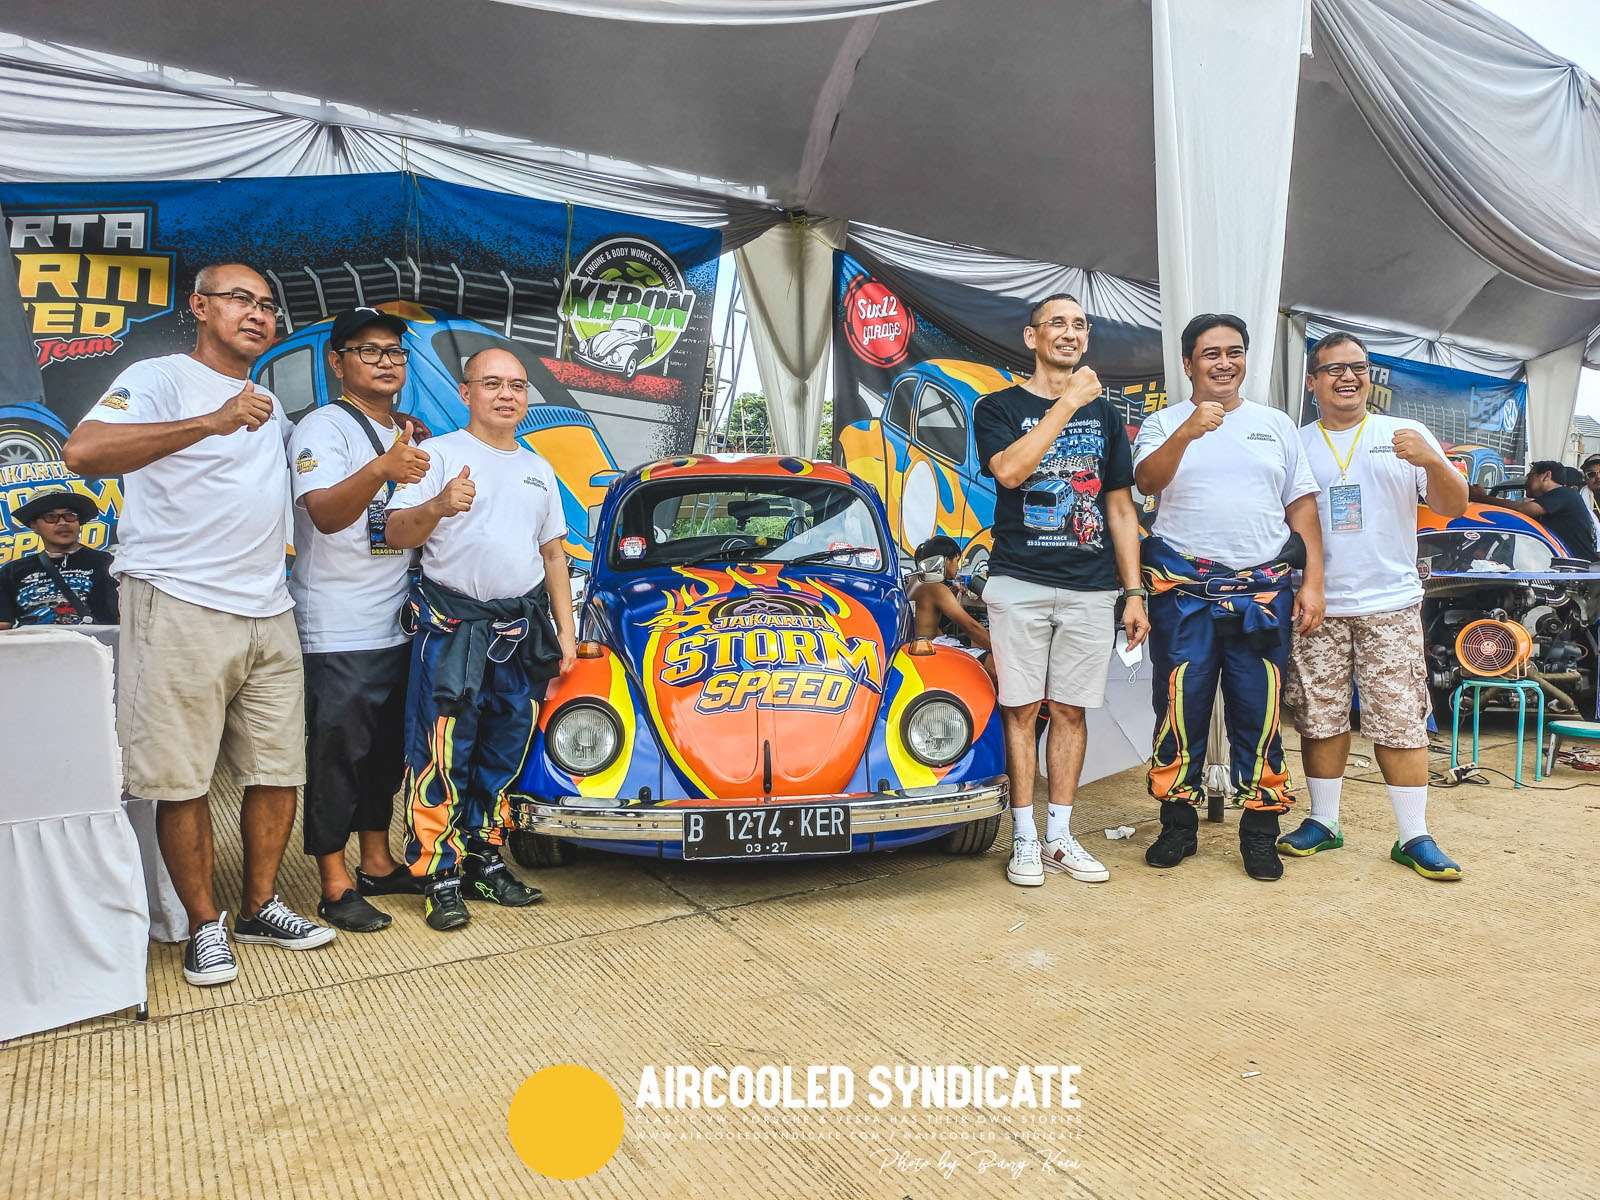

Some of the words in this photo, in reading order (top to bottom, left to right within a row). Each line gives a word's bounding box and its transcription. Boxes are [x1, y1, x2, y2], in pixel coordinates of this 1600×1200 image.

[585, 254, 606, 276] ENGINE
[605, 252, 612, 260] &
[611, 248, 629, 258] BODY
[630, 248, 653, 262] WORKS
[651, 257, 678, 291] SPECIALIST
[23, 302, 125, 336] ED
[858, 296, 898, 320] Six12
[38, 336, 119, 366] Team
[713, 614, 832, 630] JAKARTA
[661, 629, 882, 692] STORM
[697, 671, 855, 712] SPEED
[687, 814, 704, 842] B
[725, 810, 783, 840] 1274
[800, 808, 845, 837] KER
